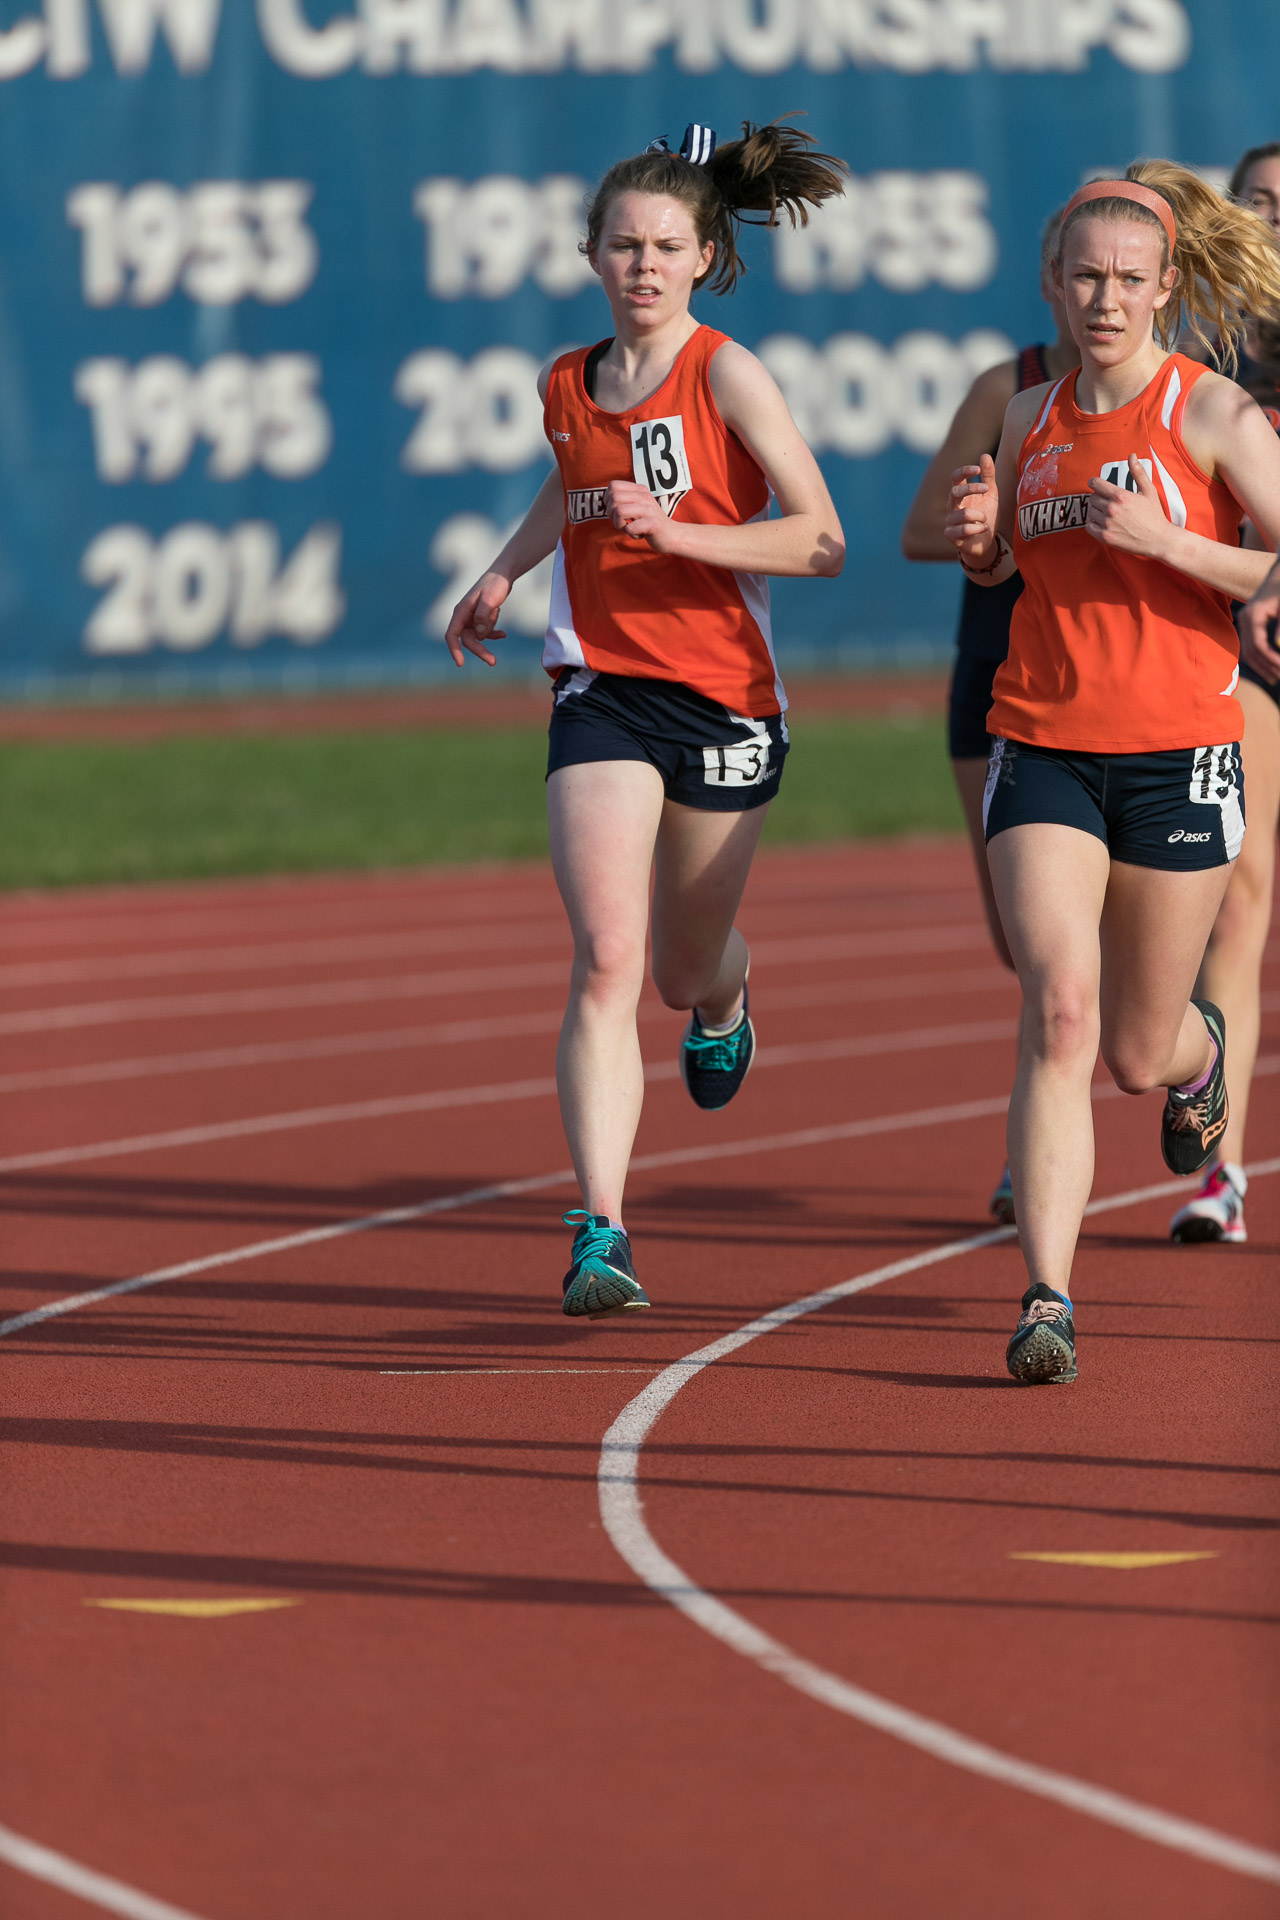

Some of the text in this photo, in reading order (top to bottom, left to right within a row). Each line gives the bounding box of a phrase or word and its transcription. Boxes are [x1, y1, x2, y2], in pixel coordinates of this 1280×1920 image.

[0, 0, 1191, 79] IW CHAMPIONSHIPS
[68, 180, 317, 306] 1953
[76, 351, 331, 483] 1995
[635, 423, 678, 492] 13
[1019, 494, 1091, 540] WHEA
[81, 520, 343, 655] 2014
[1183, 832, 1212, 843] asics
